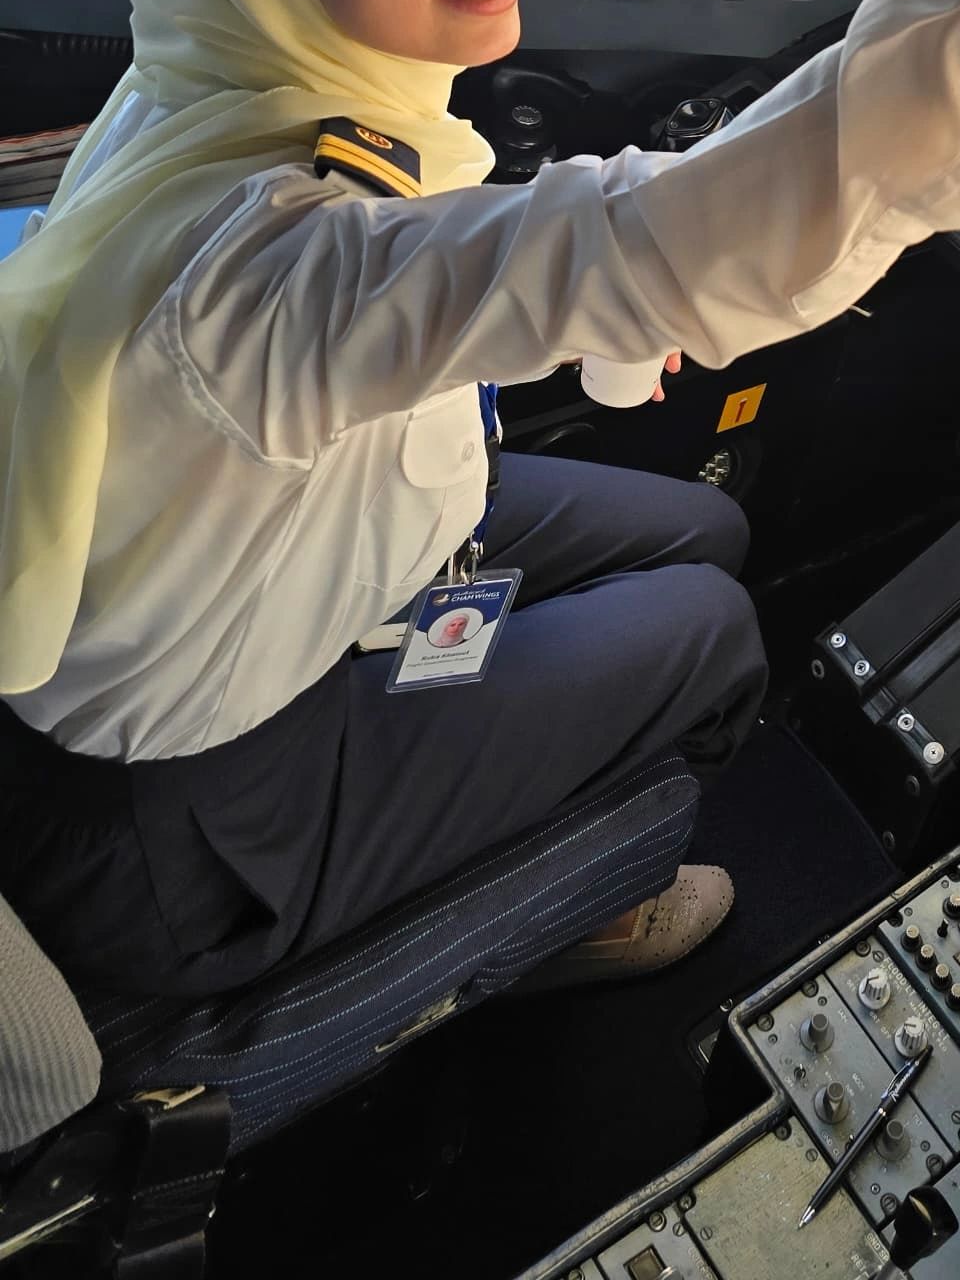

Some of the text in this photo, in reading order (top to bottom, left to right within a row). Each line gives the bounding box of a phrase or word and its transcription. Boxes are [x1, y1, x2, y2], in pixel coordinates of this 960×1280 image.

[451, 594, 474, 602] CHAM
[475, 591, 500, 600] WINGS
[882, 958, 916, 997] FLOOD LT
[918, 1002, 950, 1042] INTEG LT
[866, 1232, 881, 1254] GND
